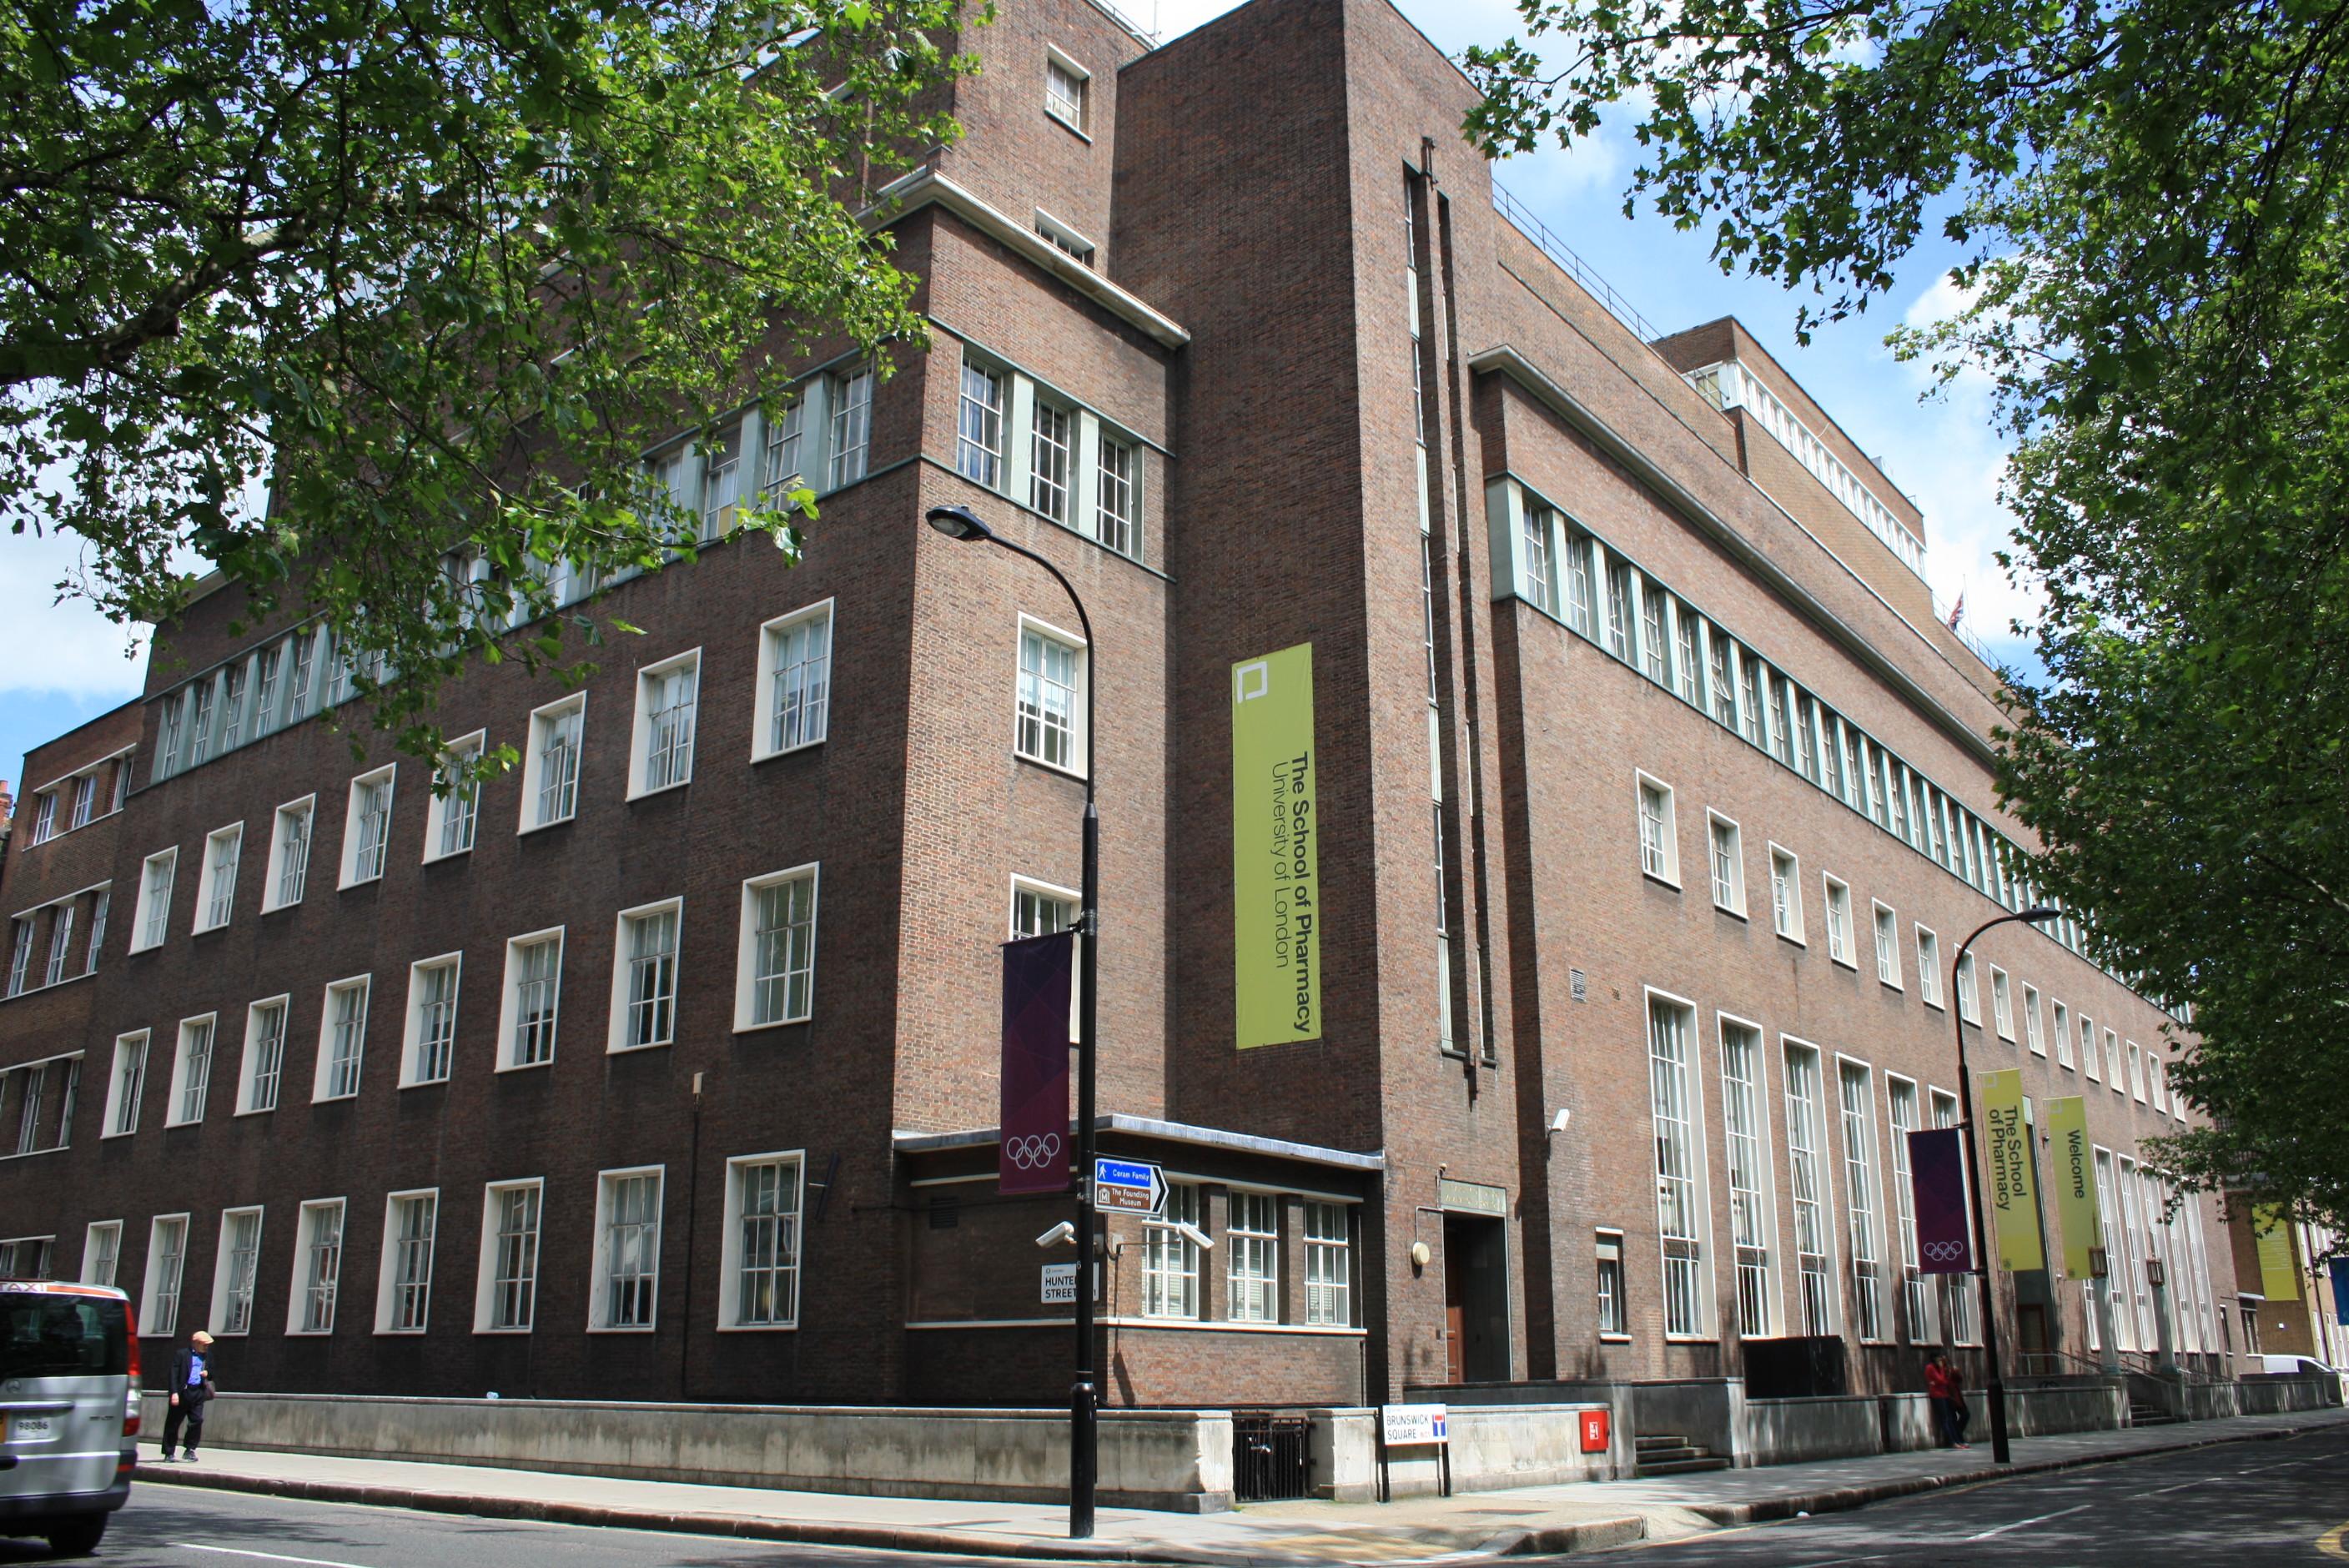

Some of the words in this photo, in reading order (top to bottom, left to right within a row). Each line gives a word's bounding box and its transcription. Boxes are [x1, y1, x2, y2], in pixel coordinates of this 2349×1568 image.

[1291, 751, 1308, 795] The
[1270, 761, 1289, 857] University
[1292, 798, 1310, 881] School
[1273, 859, 1290, 882] of
[1294, 885, 1310, 908] of
[1275, 887, 1291, 968] London
[1293, 912, 1312, 1034] Pharmacy
[1989, 1108, 2004, 1125] of
[2004, 1105, 2018, 1136] The
[1112, 1168, 1130, 1179] Coram
[1132, 1171, 1149, 1182] Family
[1991, 1128, 2010, 1212] Pharmacy
[2007, 1138, 2027, 1197] School
[2067, 1128, 2085, 1199] Welcome
[1112, 1187, 1121, 1196] The
[1123, 1189, 1149, 1201] Foundling
[1119, 1197, 1142, 1207] Museum
[0, 1283, 44, 1292] TAXI
[1045, 1275, 1077, 1287] HUNTE
[1045, 1288, 1077, 1299] STREET
[1386, 1414, 1429, 1425] BRUNSWICK
[1387, 1429, 1416, 1440] SQUARE
